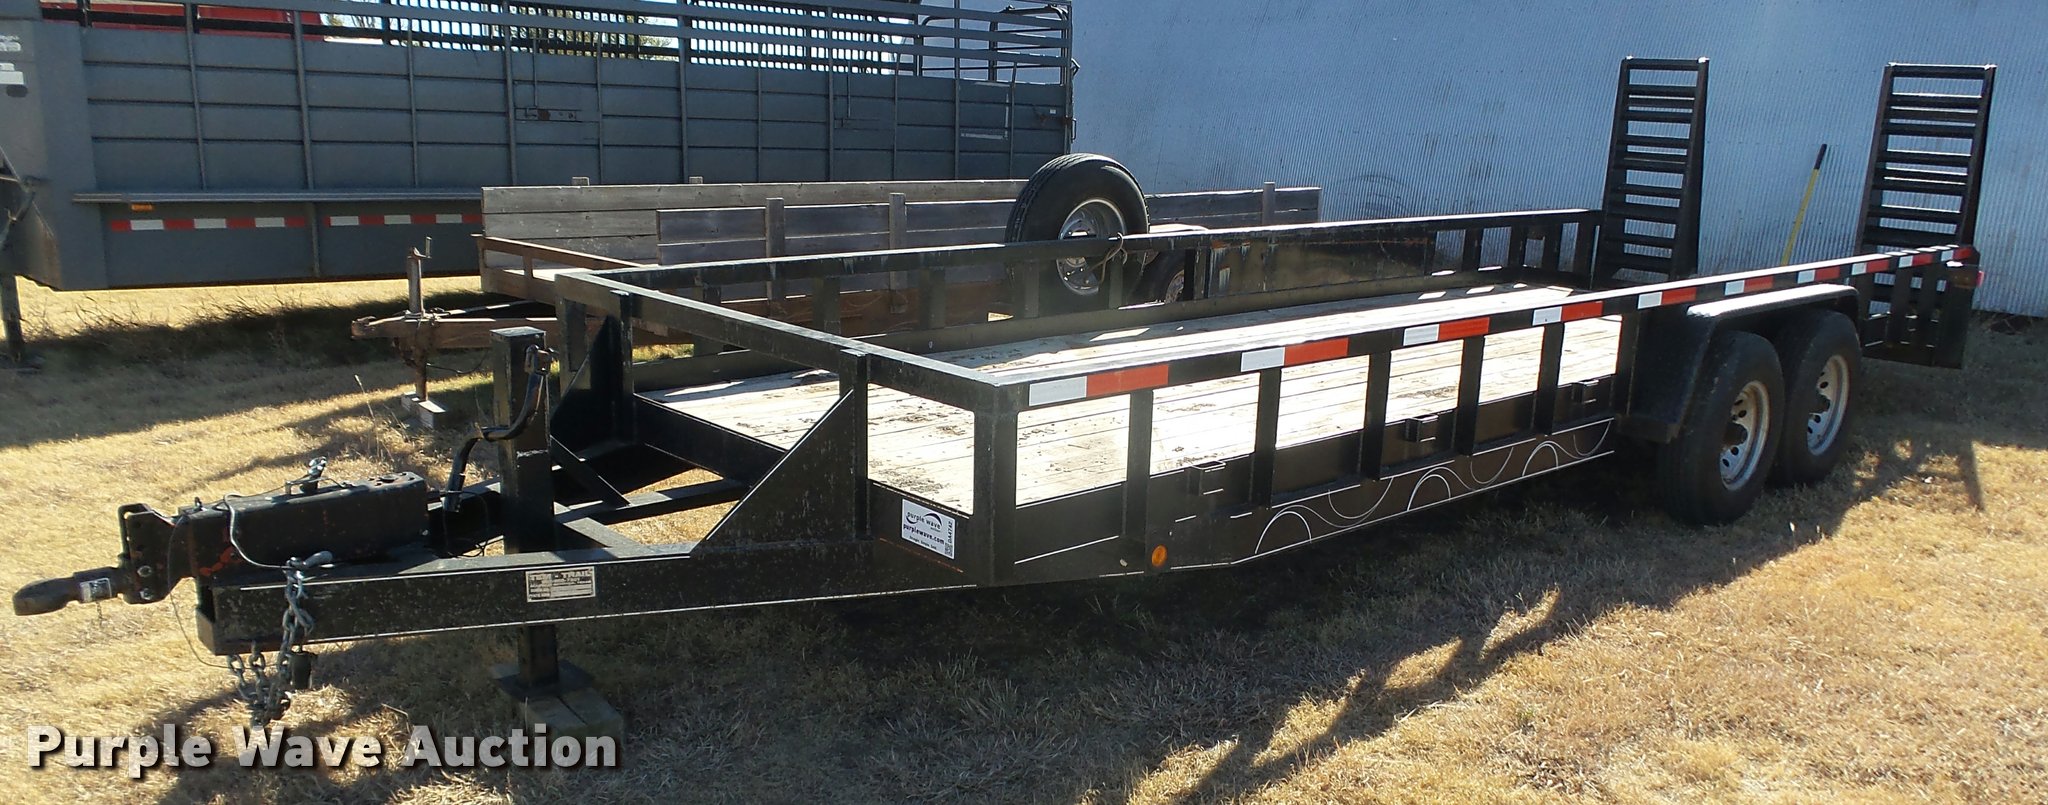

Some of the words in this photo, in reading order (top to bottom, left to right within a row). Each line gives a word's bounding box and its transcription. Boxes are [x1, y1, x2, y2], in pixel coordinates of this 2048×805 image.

[907, 512, 925, 522] purple
[925, 519, 941, 529] wave
[903, 524, 944, 544] purplewave.com
